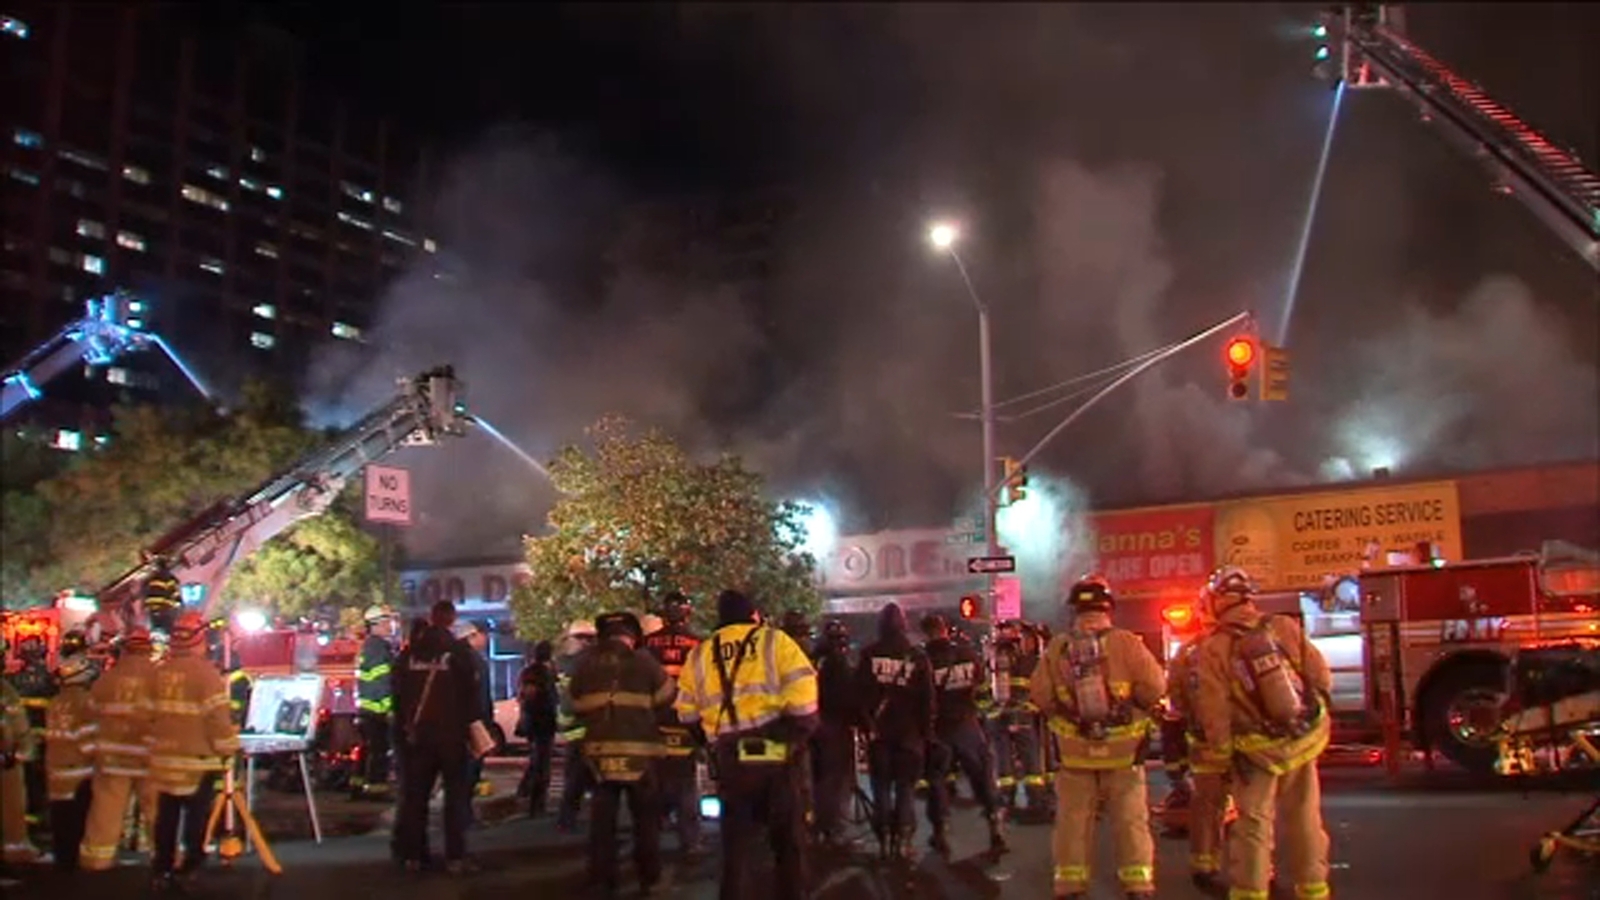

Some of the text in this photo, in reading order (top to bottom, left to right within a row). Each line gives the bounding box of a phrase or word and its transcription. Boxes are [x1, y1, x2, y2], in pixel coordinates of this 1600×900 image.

[379, 475, 398, 491] NO
[369, 494, 407, 513] TURNS
[1294, 499, 1444, 532] CATERING SERVICE
[1292, 538, 1340, 551] COFFEE
[1149, 553, 1205, 577] OPEN
